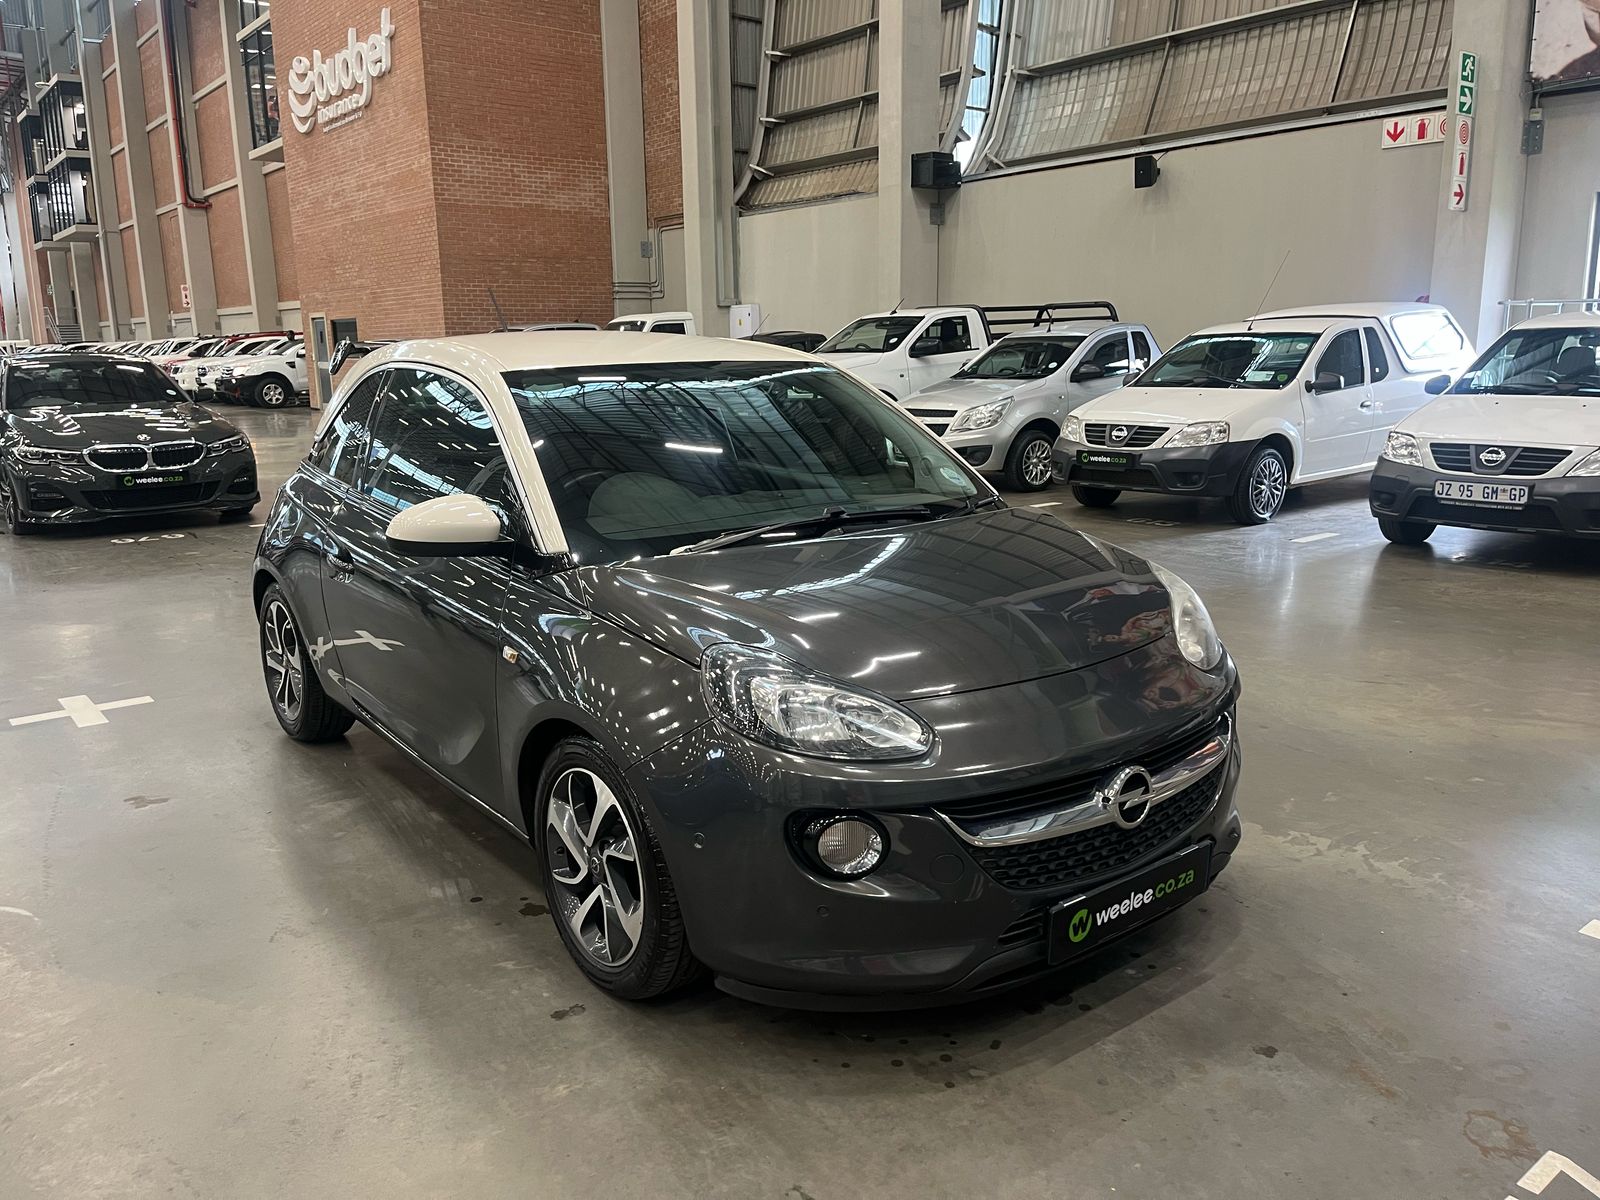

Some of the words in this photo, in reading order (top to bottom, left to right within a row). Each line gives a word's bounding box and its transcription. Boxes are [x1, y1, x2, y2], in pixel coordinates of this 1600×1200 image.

[313, 7, 396, 107] budget
[1437, 482, 1452, 496] JZ
[1458, 484, 1473, 498] 95
[1482, 486, 1499, 500] GM
[1509, 488, 1526, 502] GP
[1096, 869, 1195, 926] weelee.co.za
